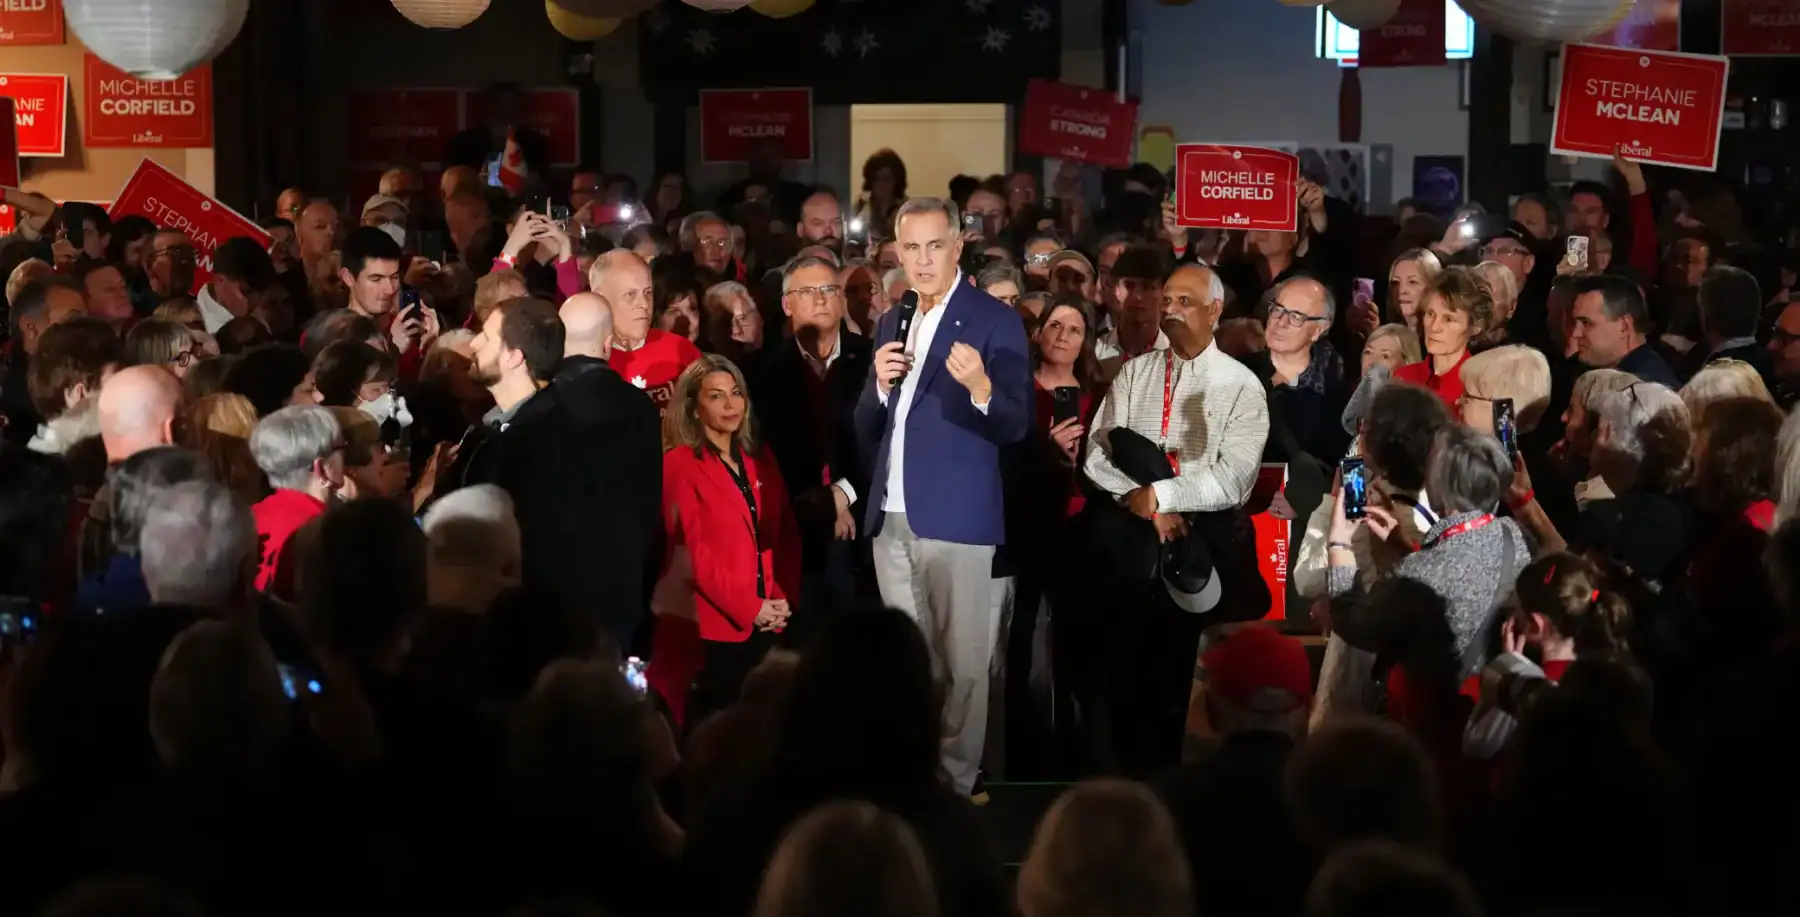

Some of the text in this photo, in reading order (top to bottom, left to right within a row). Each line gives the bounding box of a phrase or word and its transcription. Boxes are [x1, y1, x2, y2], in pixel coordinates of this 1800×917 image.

[0, 0, 46, 12] IELD
[100, 80, 195, 96] MICHELLE
[1585, 78, 1697, 107] STEPHANIE
[100, 99, 195, 115] CORFIELD
[1596, 101, 1680, 126] MCLEAN
[1615, 142, 1652, 157] iberal
[1200, 170, 1275, 185] MICHELLE
[1200, 186, 1274, 200] CORFIELD
[1222, 215, 1250, 225] Liberal
[1274, 538, 1287, 582] Liberal
